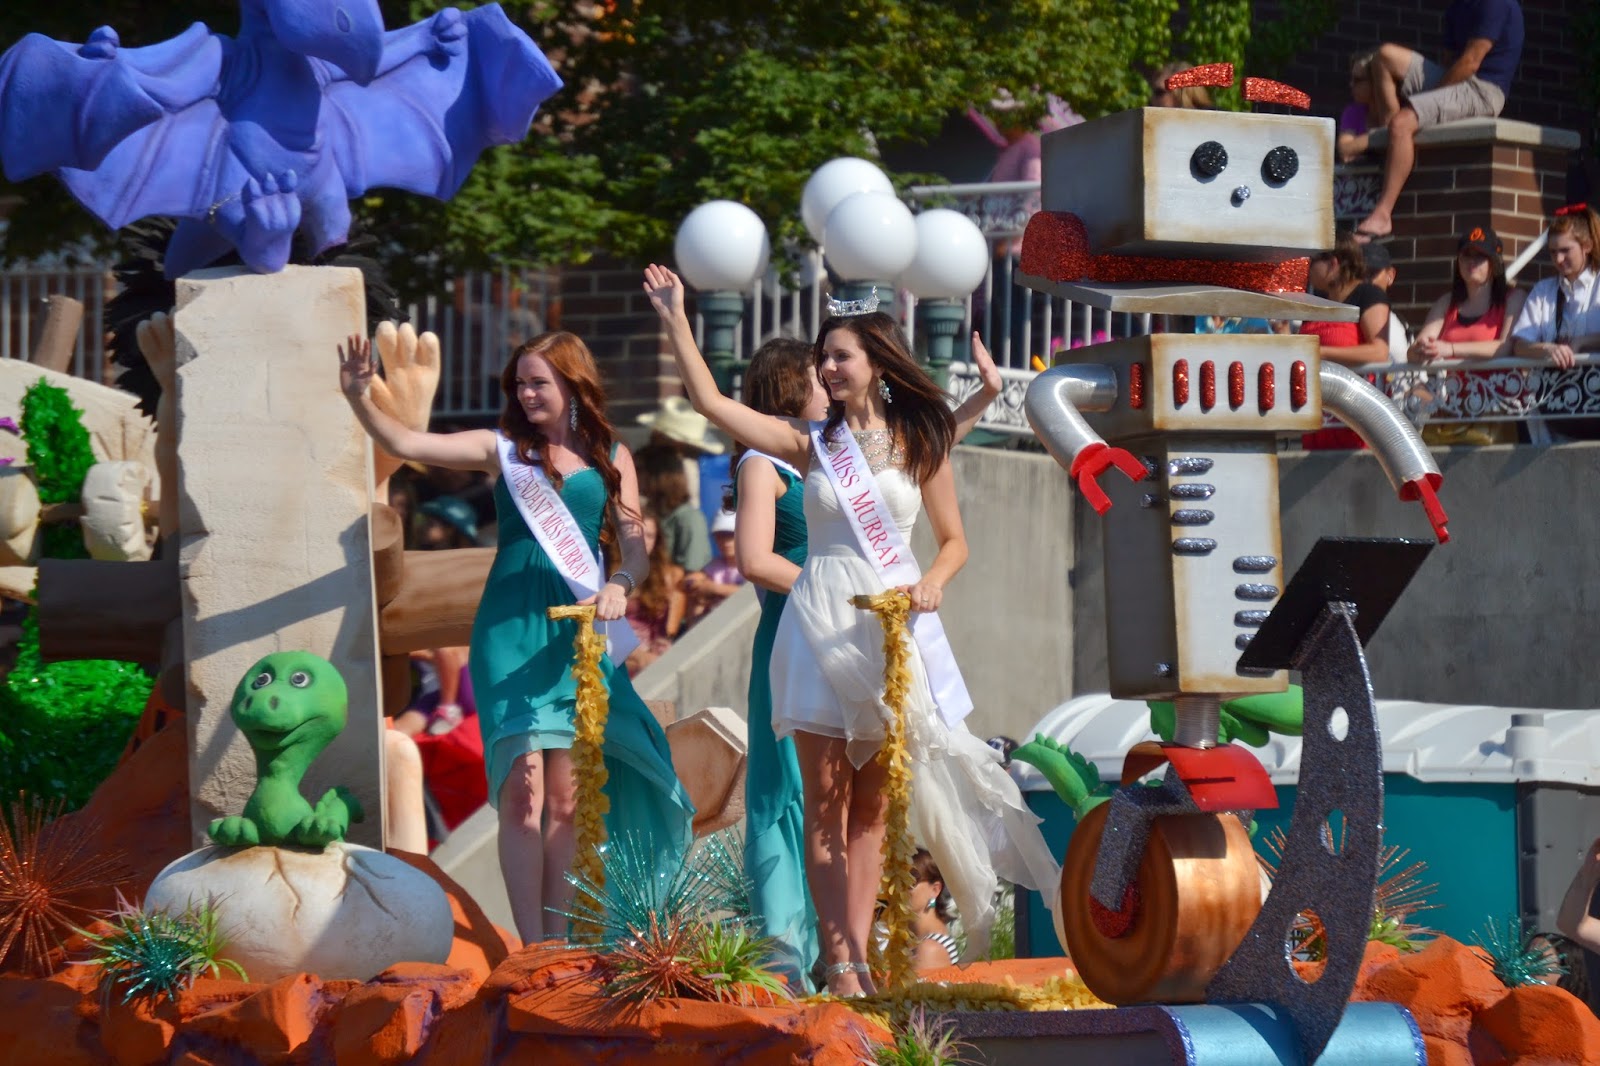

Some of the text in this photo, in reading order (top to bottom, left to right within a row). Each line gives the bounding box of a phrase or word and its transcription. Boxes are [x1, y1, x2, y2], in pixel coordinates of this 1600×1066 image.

[510, 465, 591, 580] ATTENDANT MISS MURRAY
[828, 446, 860, 488] MISS
[848, 489, 900, 569] MURRAY
